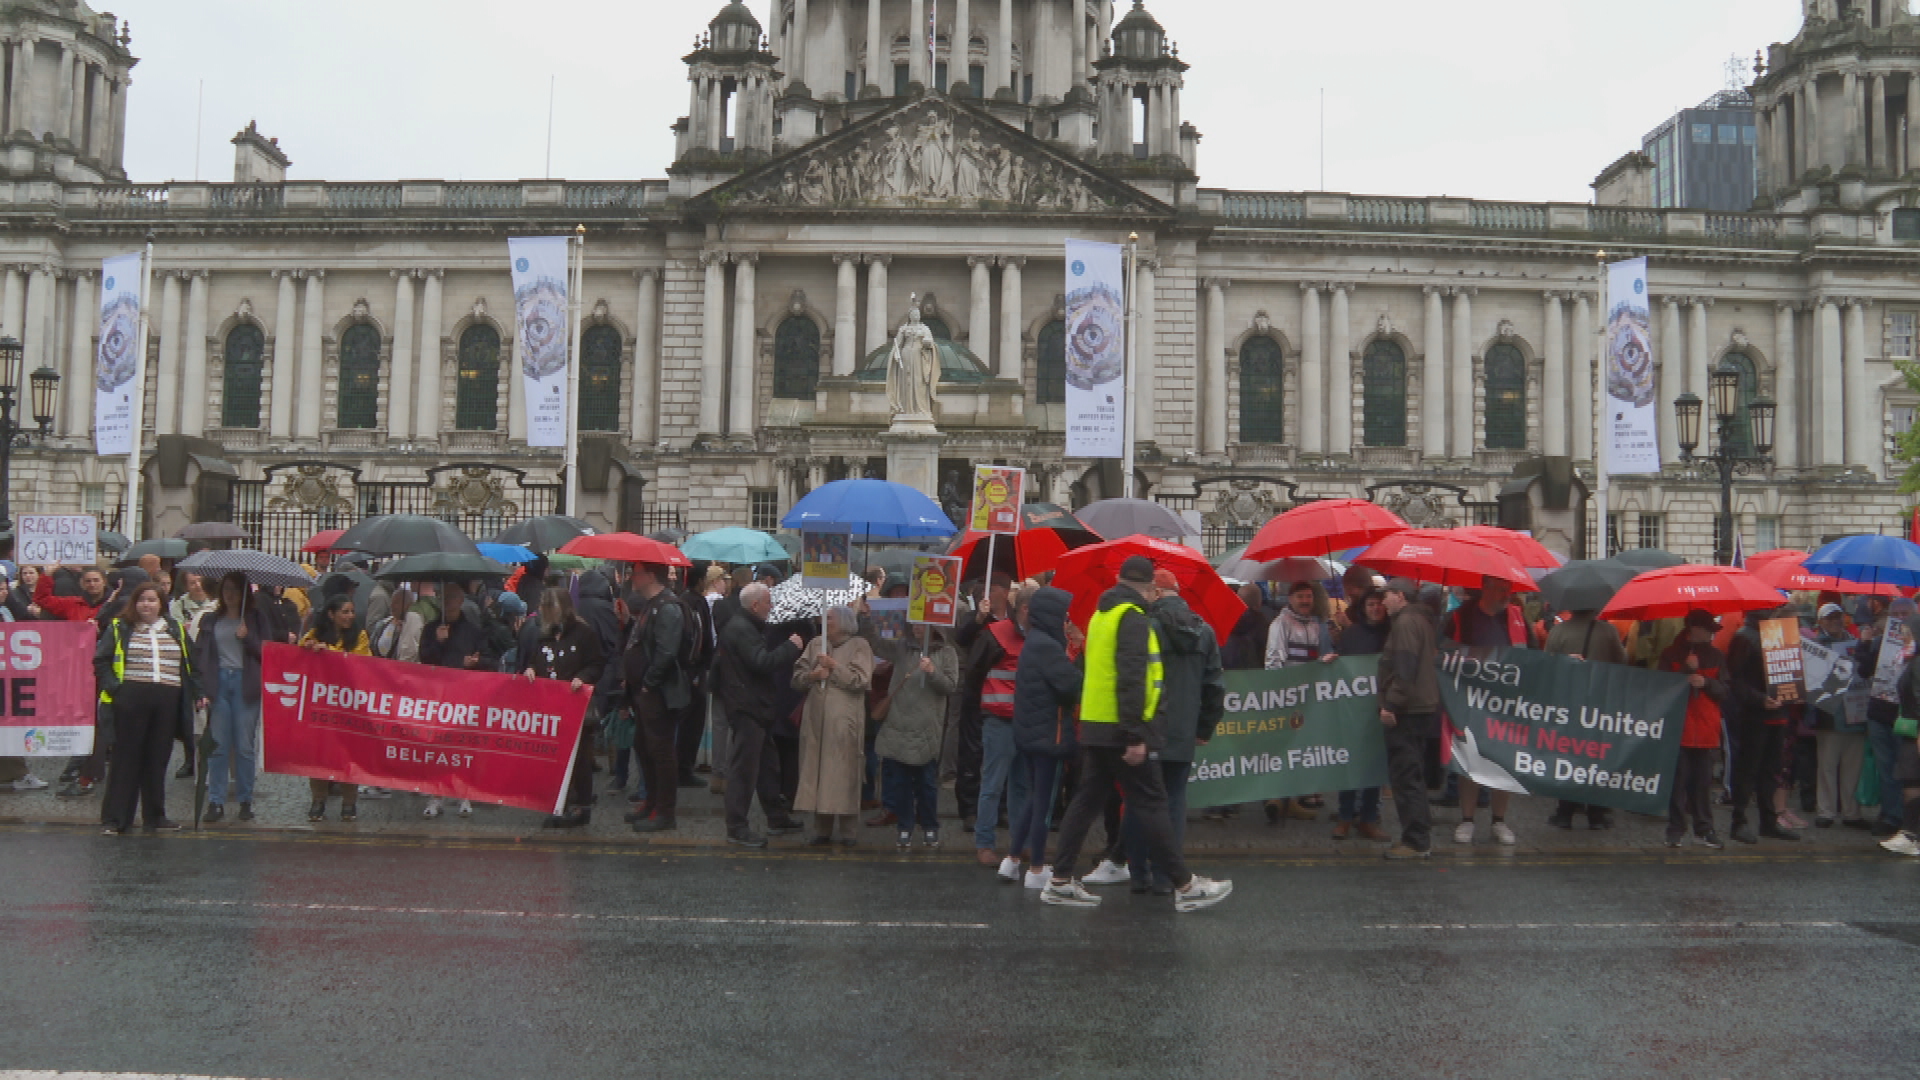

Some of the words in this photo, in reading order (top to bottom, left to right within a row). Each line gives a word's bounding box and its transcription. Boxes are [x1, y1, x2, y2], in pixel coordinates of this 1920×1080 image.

[22, 517, 89, 535] RACISTS
[24, 540, 48, 560] GO
[53, 540, 95, 560] HOME
[0, 629, 42, 671] S
[0, 677, 37, 717] E
[311, 681, 394, 715] PEOPLE
[397, 695, 481, 727] BEFORE
[486, 705, 562, 737] PROFIT
[1467, 685, 1570, 725] Workers
[1580, 705, 1665, 740] United
[310, 711, 385, 733] SOCIALISM
[391, 725, 420, 738] FOR
[426, 730, 454, 743] THE
[494, 736, 558, 755] CENTURY
[1216, 717, 1286, 737] BELFAST
[1486, 717, 1530, 747] Will
[1537, 727, 1612, 760] Never
[385, 745, 474, 769] BELFAST
[1287, 745, 1350, 770] Fáilte
[1515, 751, 1547, 777] Be
[1554, 757, 1661, 795] Defeated
